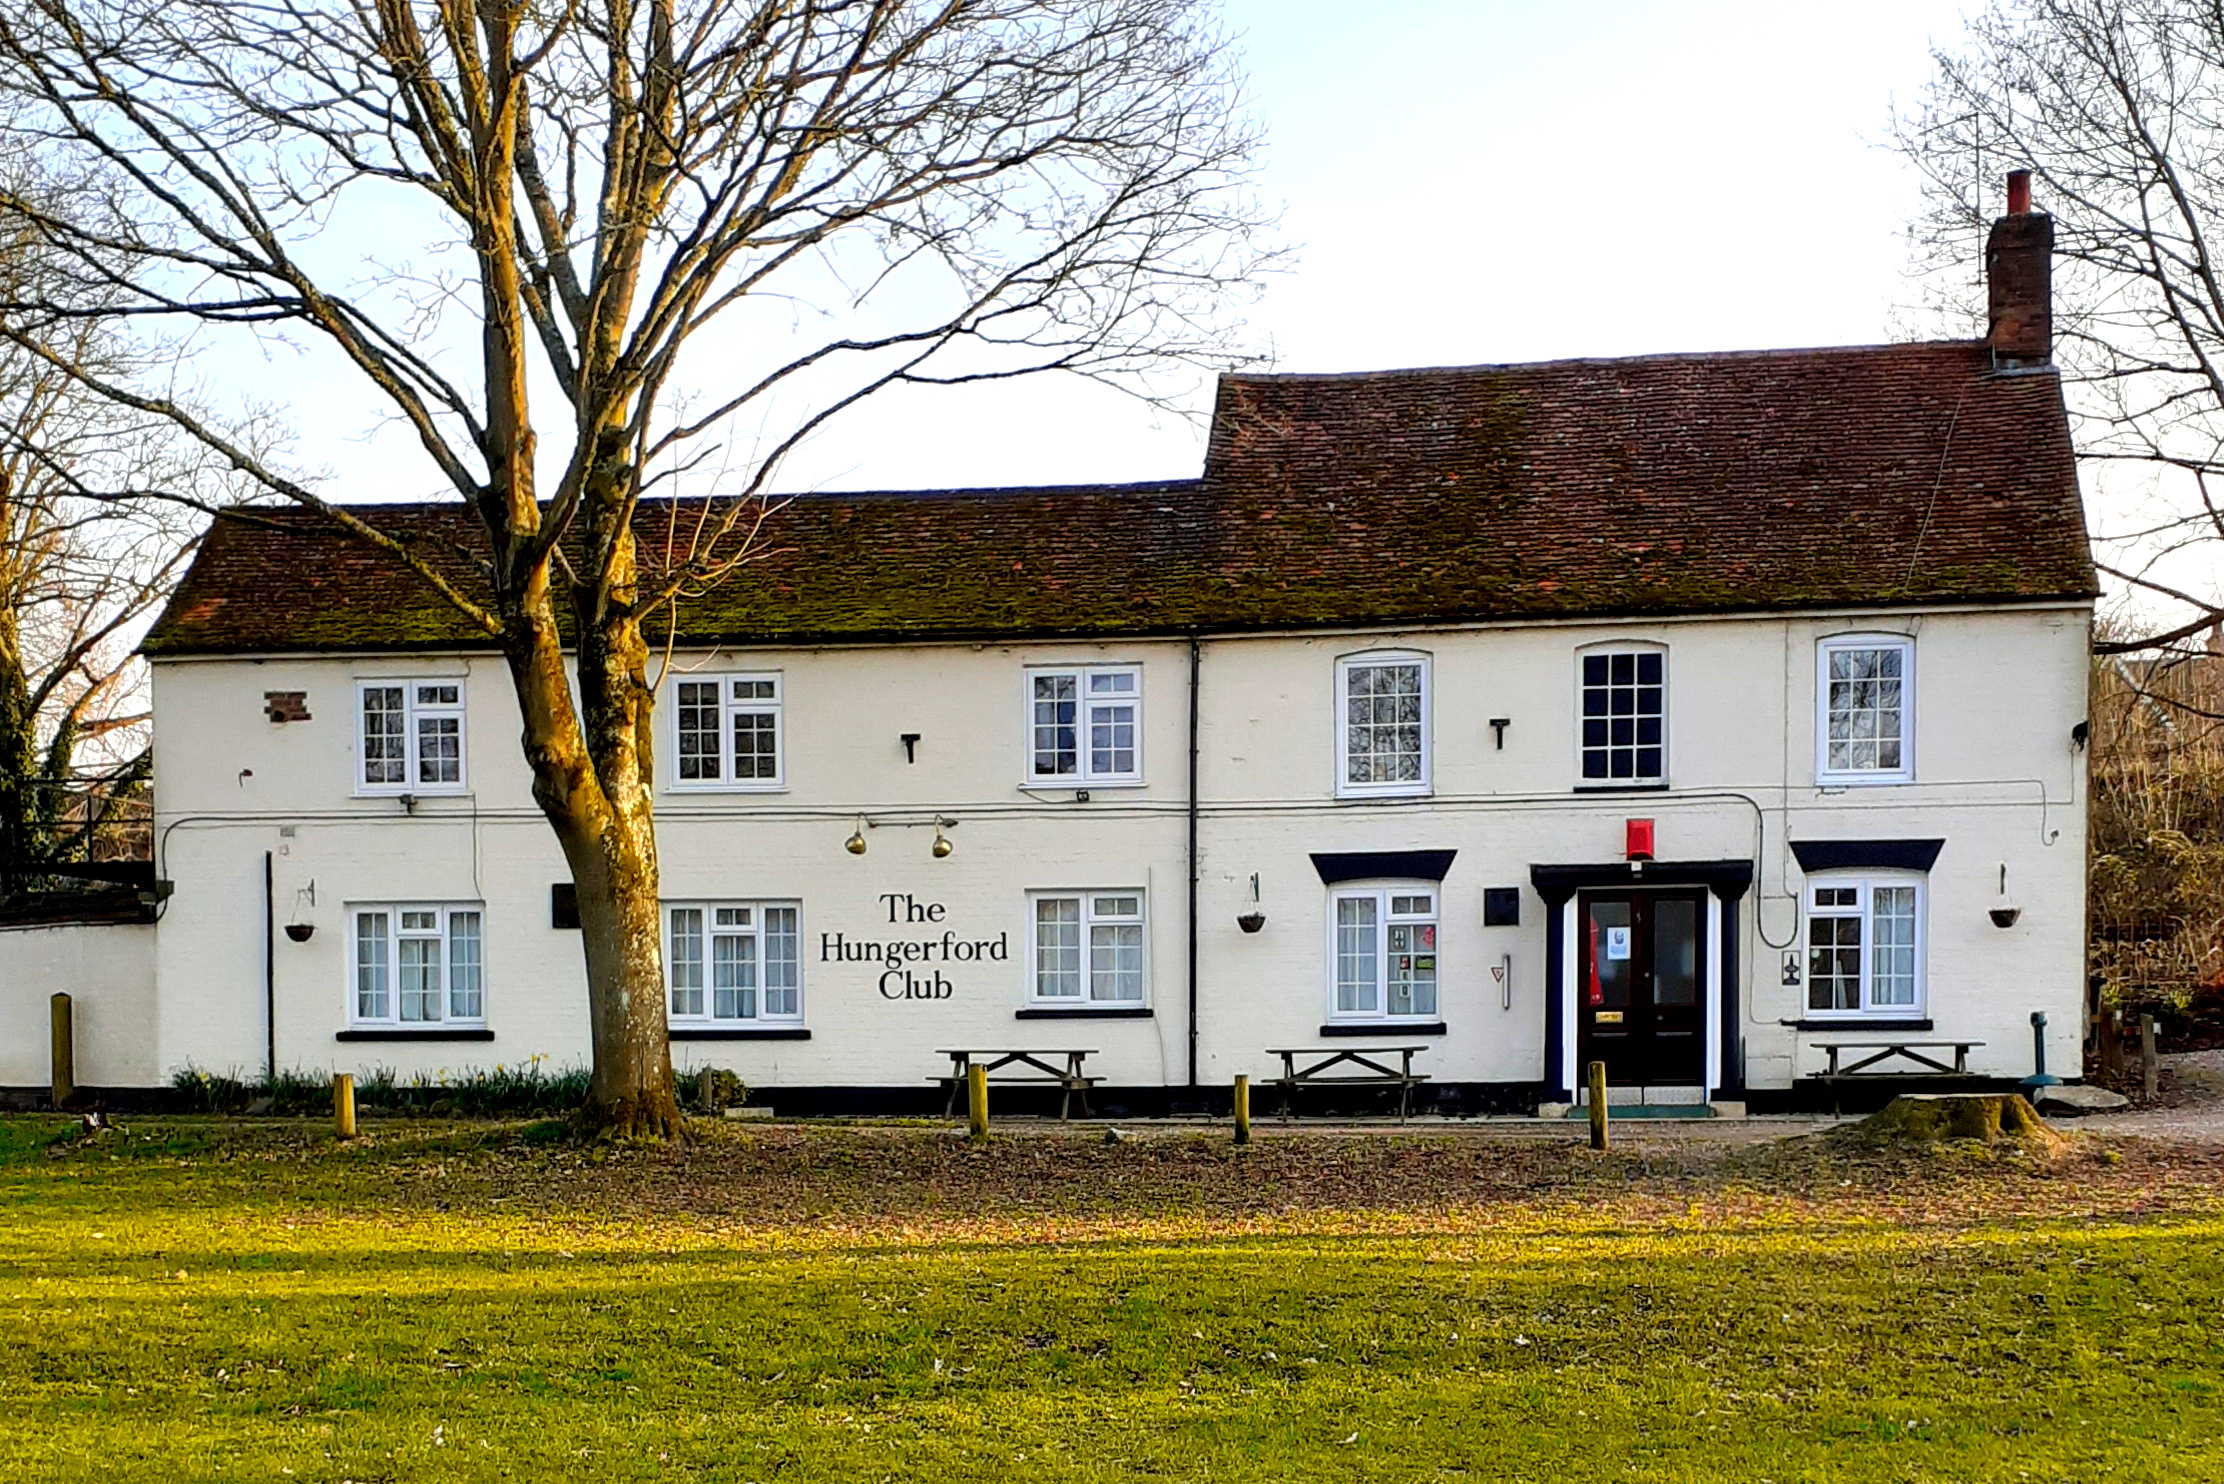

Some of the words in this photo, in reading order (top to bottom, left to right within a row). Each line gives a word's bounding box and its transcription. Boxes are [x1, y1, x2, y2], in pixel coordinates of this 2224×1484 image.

[879, 893, 946, 923] The
[820, 931, 1008, 970] Hungerford
[878, 970, 953, 1000] Club
